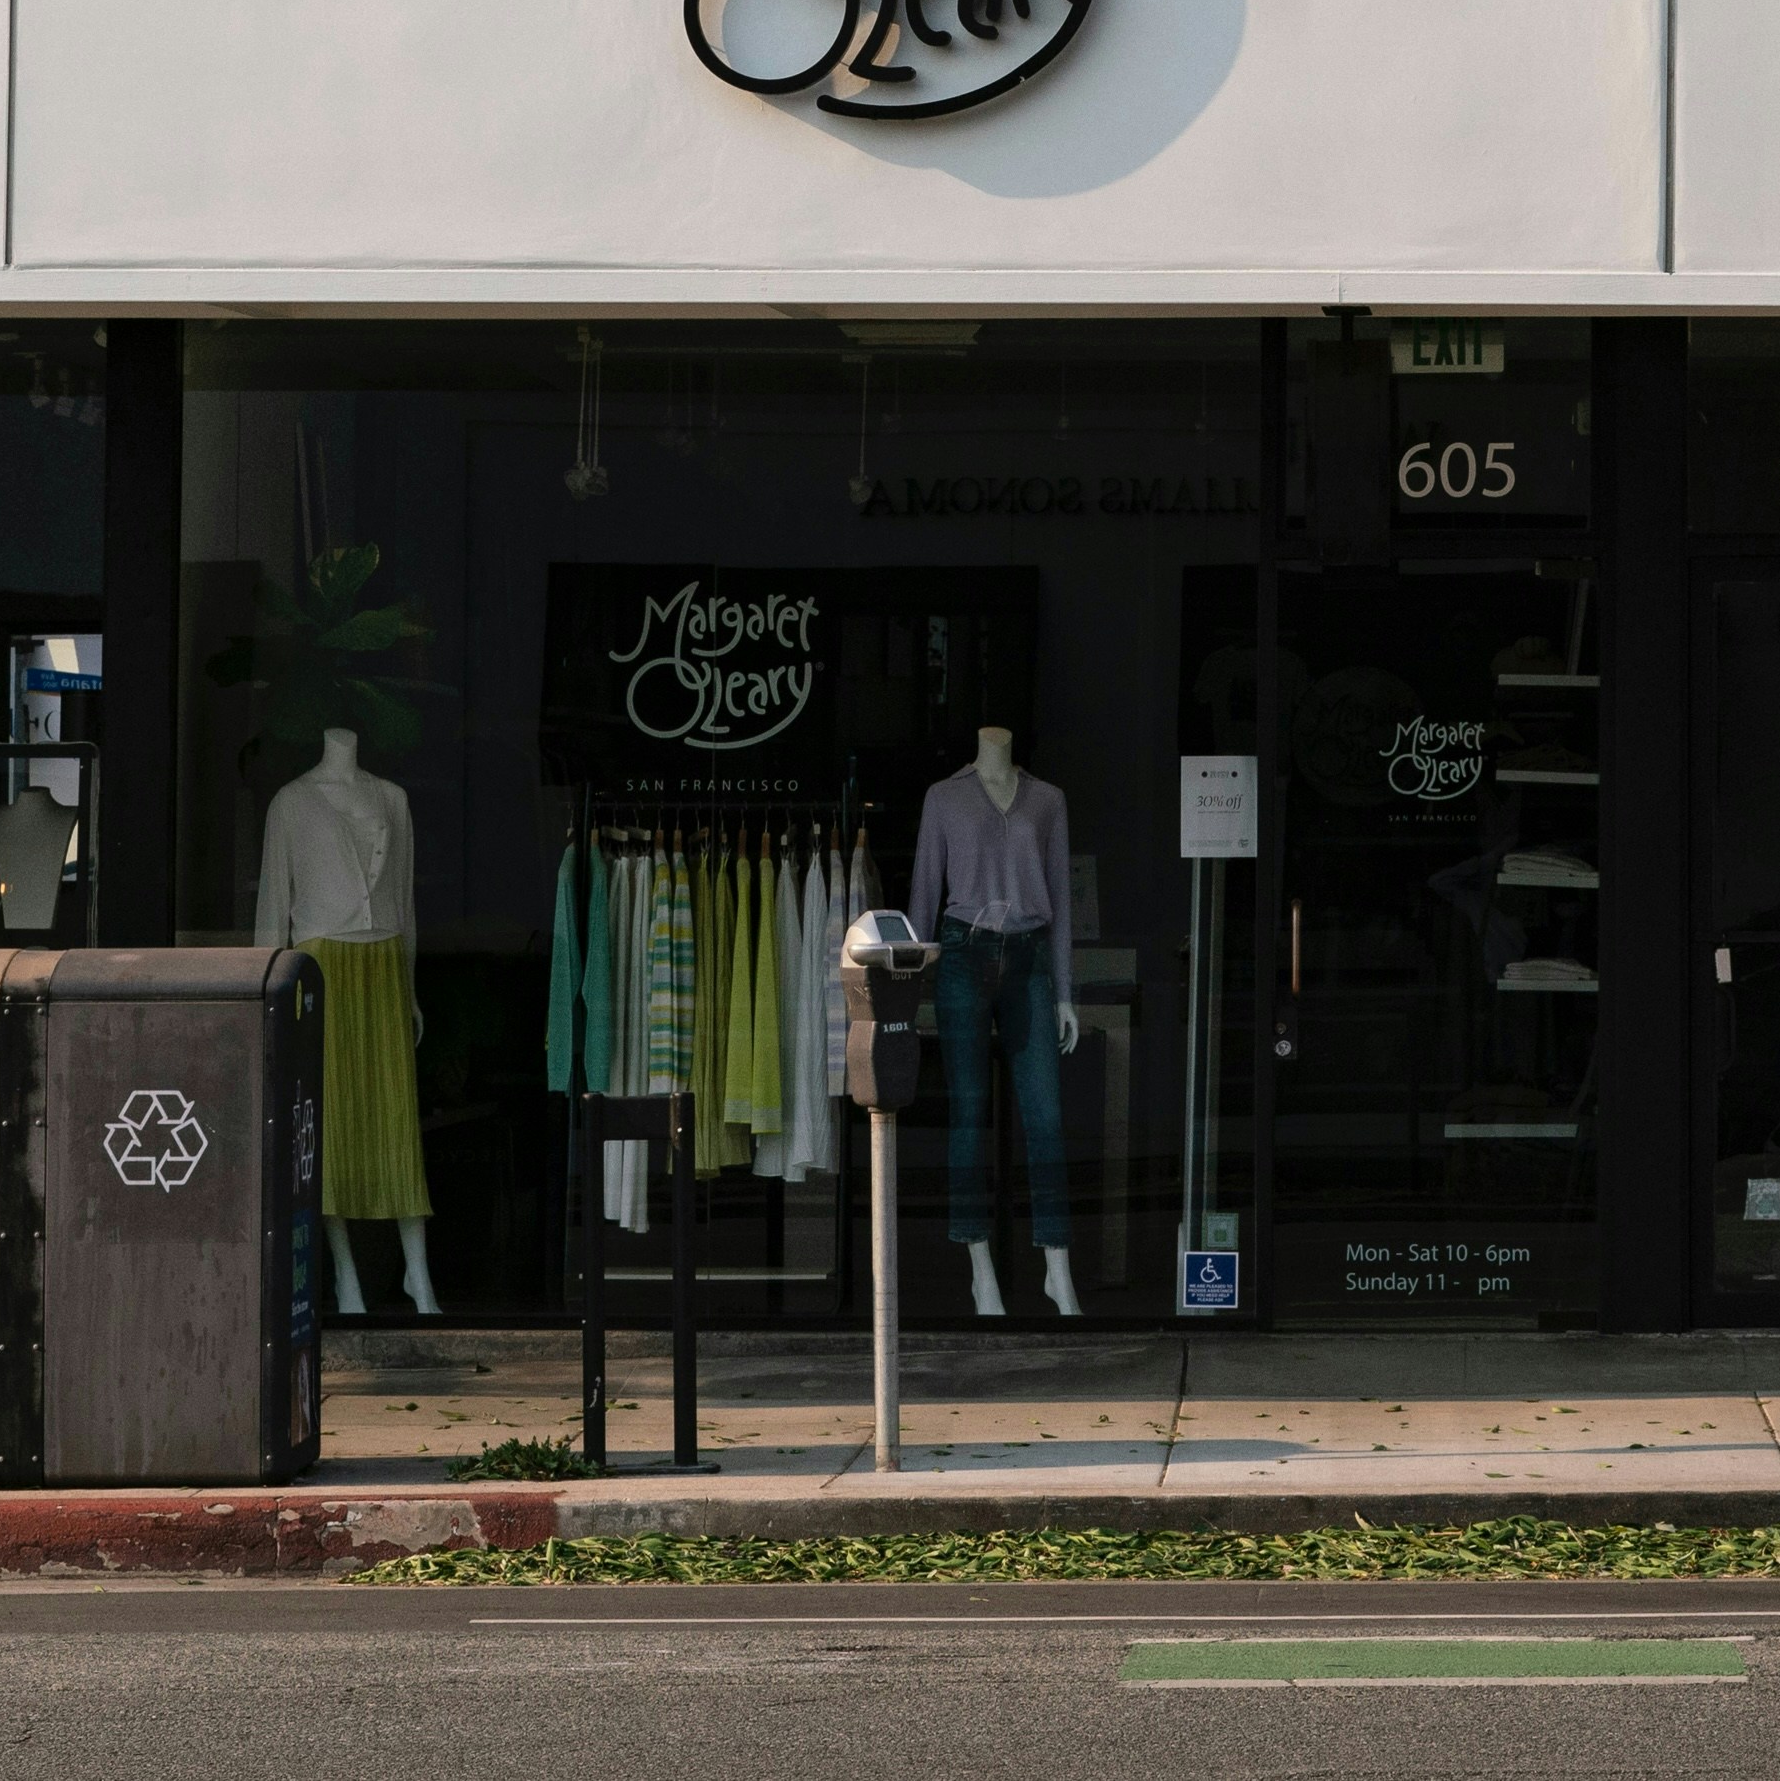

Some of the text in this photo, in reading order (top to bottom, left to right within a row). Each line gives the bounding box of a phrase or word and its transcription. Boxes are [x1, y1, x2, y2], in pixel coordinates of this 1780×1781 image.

[1413, 318, 1482, 365] EXIT
[1399, 442, 1515, 498] 605
[608, 580, 820, 663] Margaret
[1378, 714, 1486, 757] Margaret
[626, 779, 799, 792] SAN FRANCISCO
[1196, 793, 1244, 810] 30% off
[1388, 814, 1477, 822] SAN FRANCISCO
[883, 1022, 909, 1033] 1601
[1346, 1243, 1390, 1262] Mon
[1408, 1243, 1439, 1262] Sat
[1445, 1244, 1468, 1262] 10
[1485, 1244, 1530, 1266] 6pm
[1345, 1272, 1420, 1296] Sunday
[1425, 1273, 1445, 1290] 11
[1478, 1277, 1511, 1295] pm
